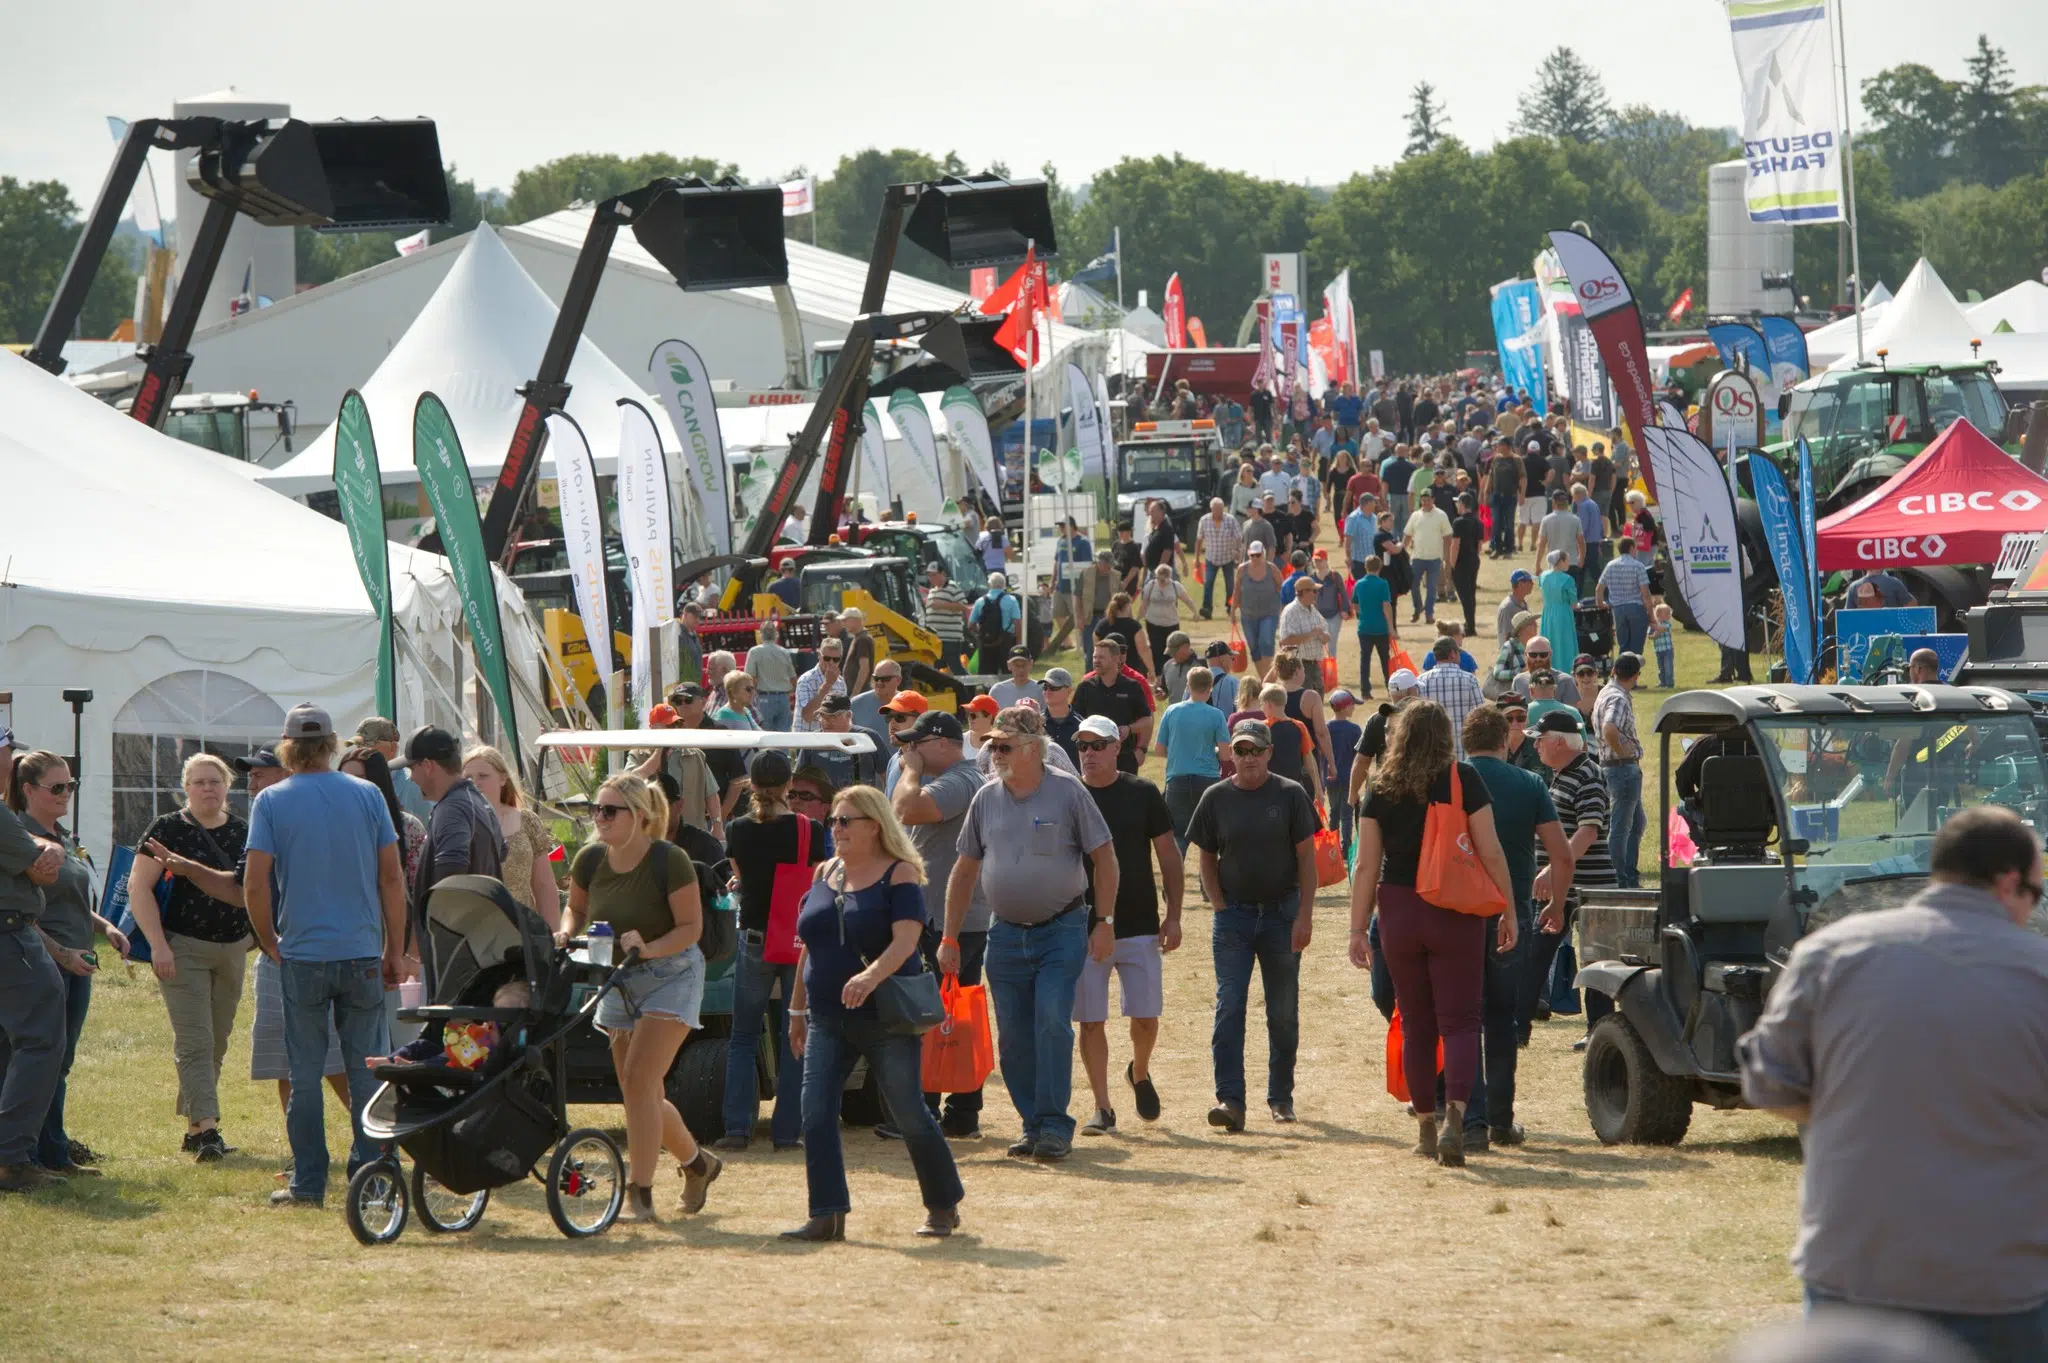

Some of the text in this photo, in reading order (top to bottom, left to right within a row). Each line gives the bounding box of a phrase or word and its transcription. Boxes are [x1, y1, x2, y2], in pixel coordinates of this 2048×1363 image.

[1579, 276, 1620, 300] QS
[748, 394, 804, 405] CLAAS
[1714, 386, 1754, 416] QS
[501, 403, 541, 490] MANITOU
[676, 389, 720, 493] CANGROW
[1898, 491, 1995, 515] CIBC
[425, 459, 494, 657] Technology Inspires Growth
[1689, 545, 1729, 554] DEUTZ
[1694, 554, 1727, 562] FAHR
[1857, 537, 1918, 560] CIBC
[1774, 520, 1800, 632] Timac AGRO
